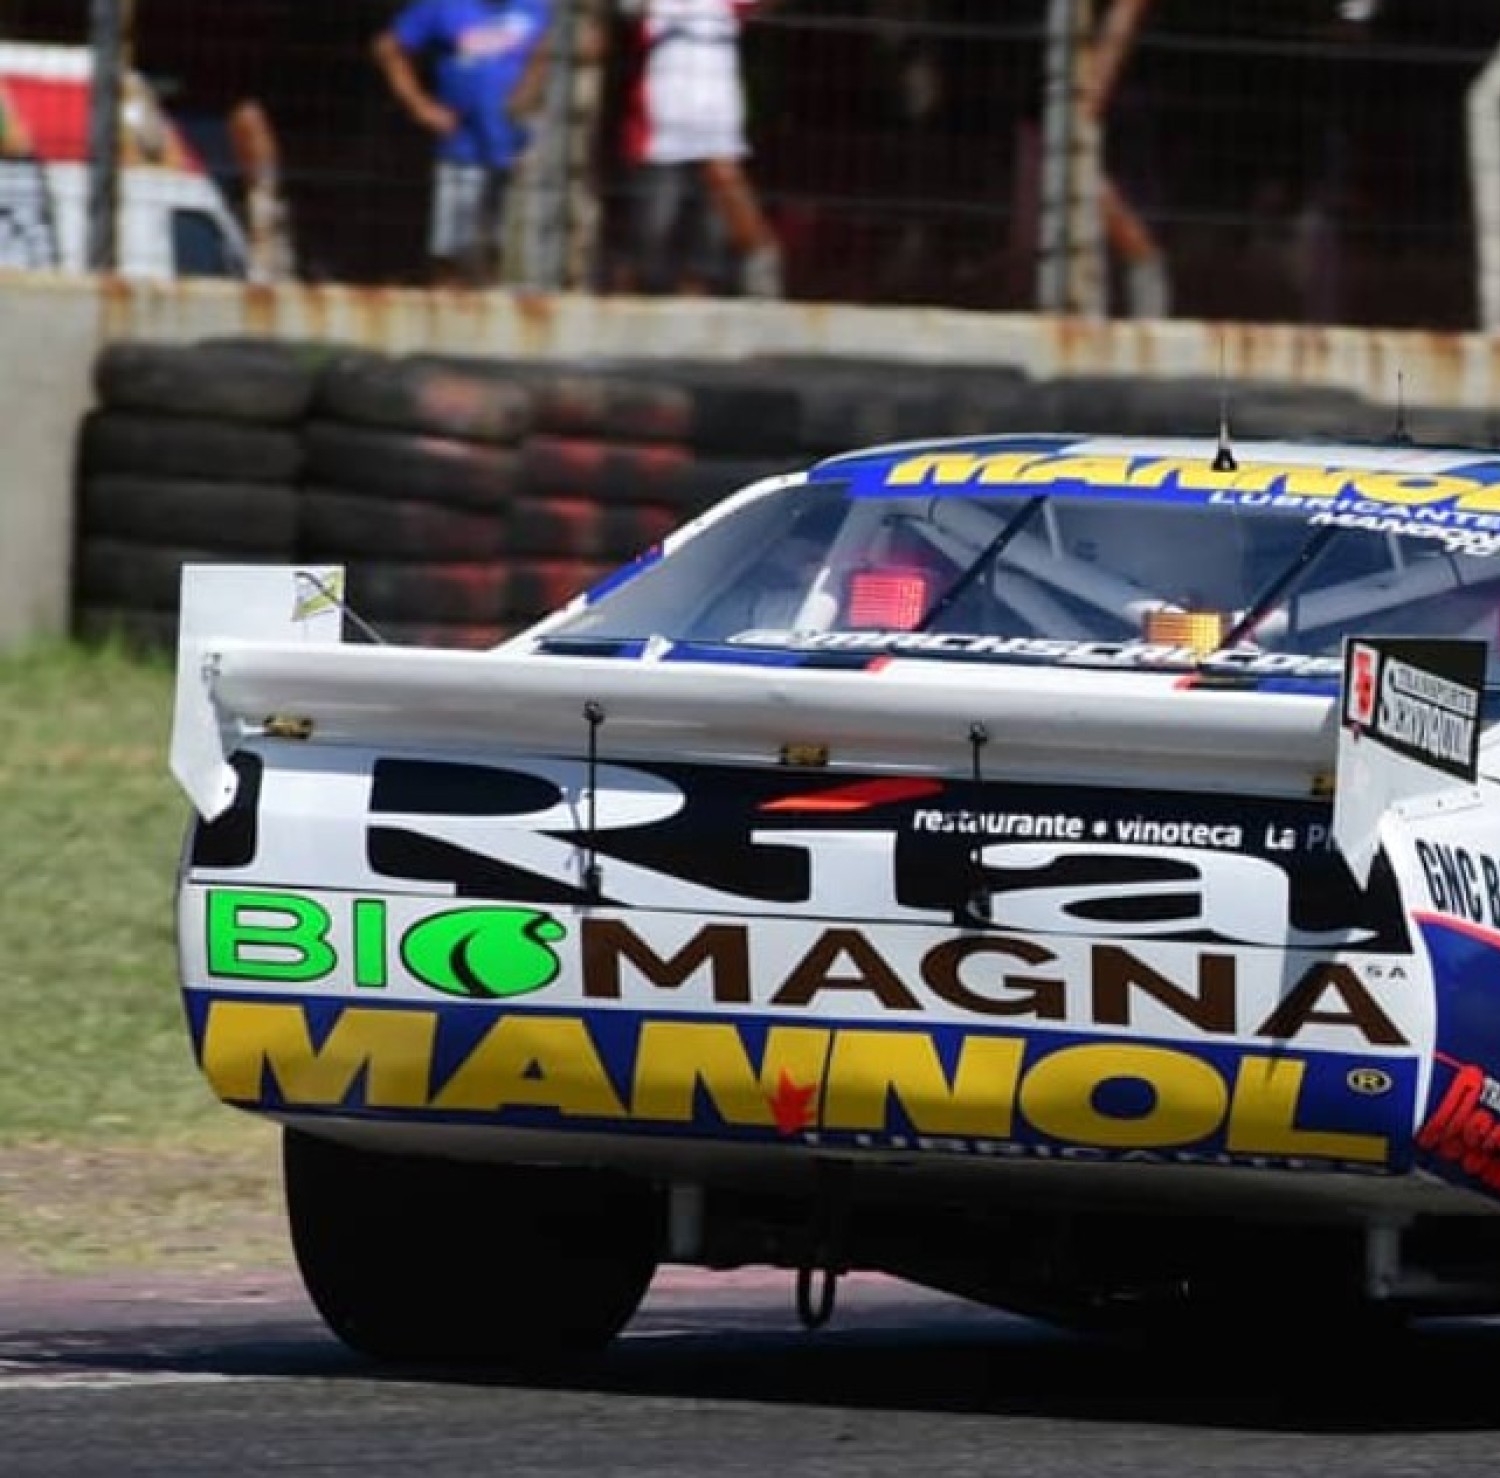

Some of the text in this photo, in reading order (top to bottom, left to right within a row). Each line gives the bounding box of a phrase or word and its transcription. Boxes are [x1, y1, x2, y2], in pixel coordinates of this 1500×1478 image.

[914, 808, 1083, 839] restaurante
[1116, 818, 1242, 848] vinoteca
[1265, 825, 1296, 850] La
[1415, 838, 1482, 924] GNC
[202, 1001, 1389, 1164] MANNOL
